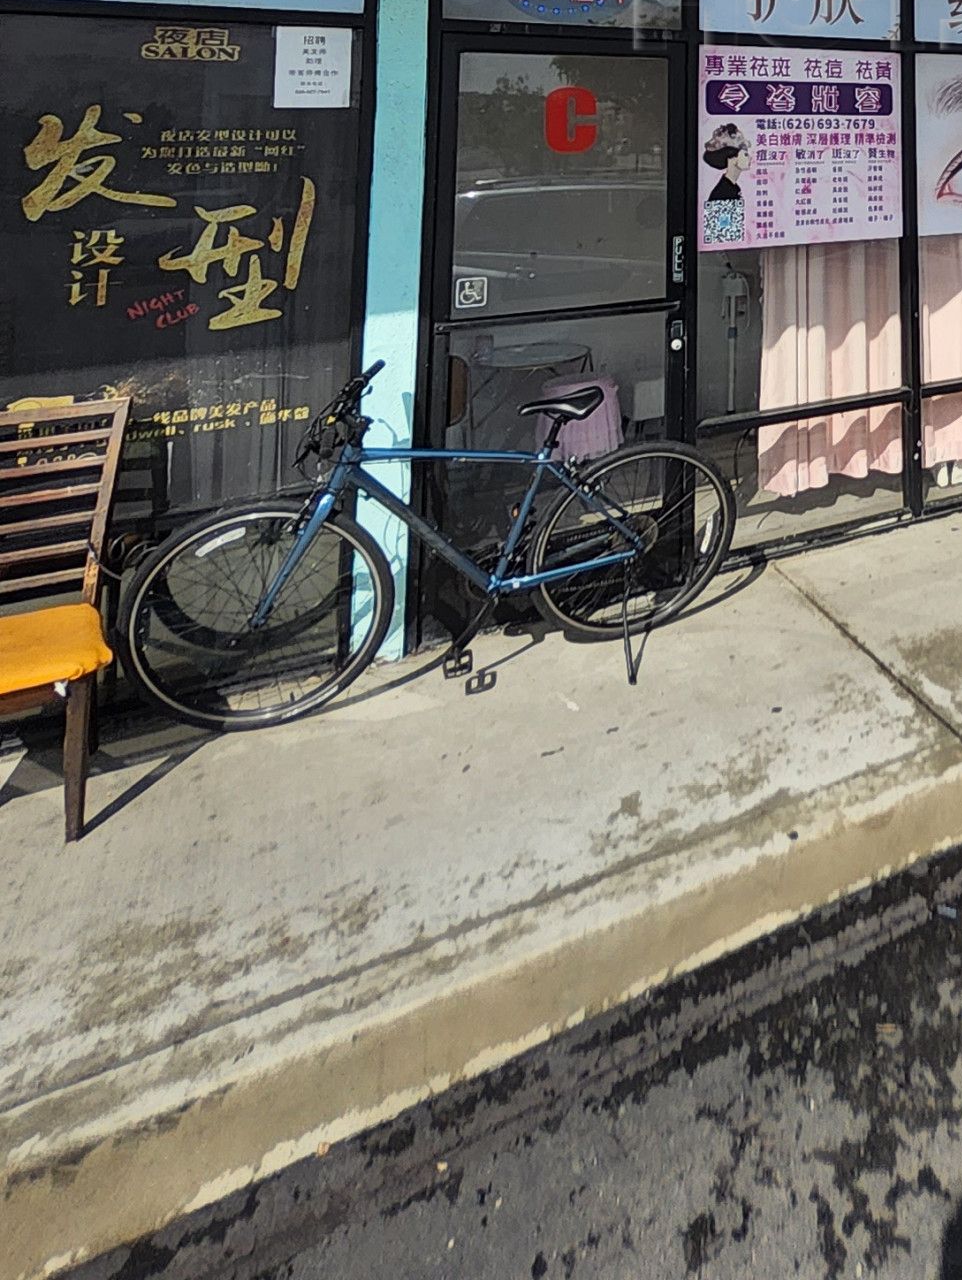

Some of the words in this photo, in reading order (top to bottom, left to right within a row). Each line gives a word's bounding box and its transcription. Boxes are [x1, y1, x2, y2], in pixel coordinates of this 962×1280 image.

[156, 27, 228, 46] 夜店
[303, 36, 326, 45] 招聘
[143, 44, 239, 60] SALON
[544, 86, 598, 154] C
[65, 229, 124, 307] 设计
[127, 289, 185, 320] NIGHT
[155, 303, 200, 330] CLUB
